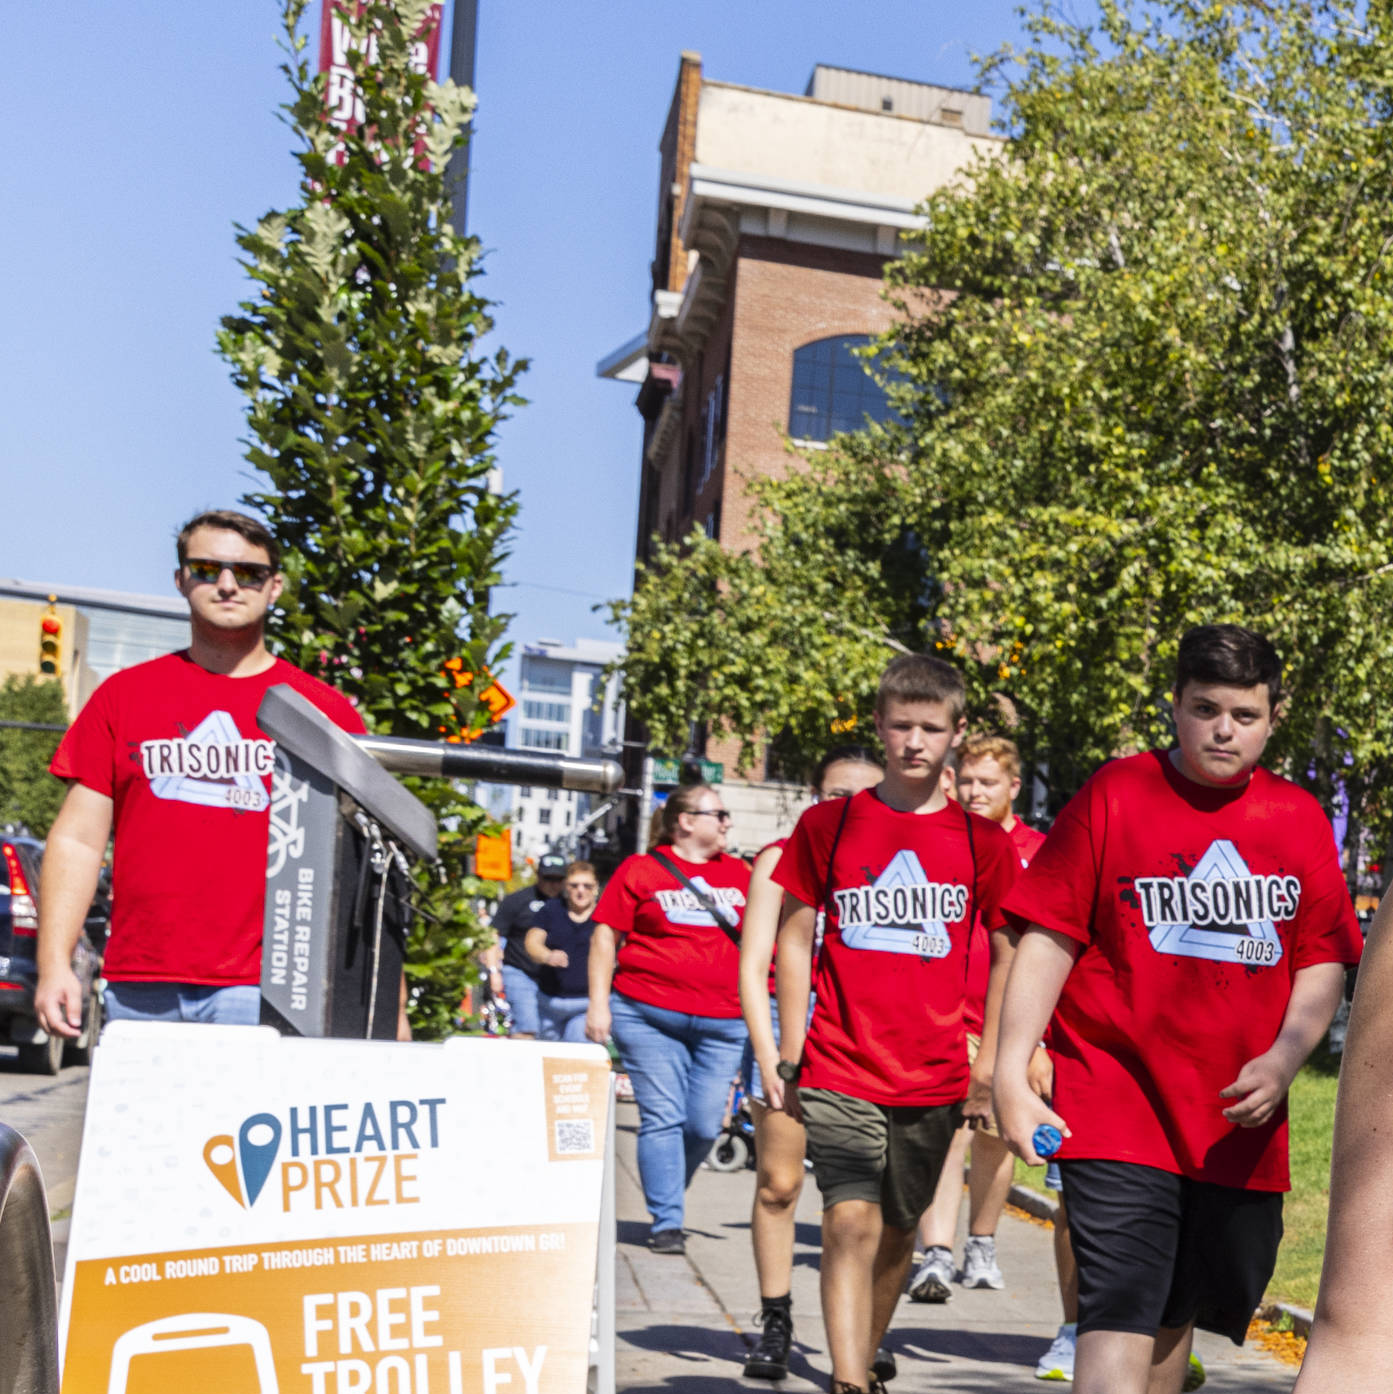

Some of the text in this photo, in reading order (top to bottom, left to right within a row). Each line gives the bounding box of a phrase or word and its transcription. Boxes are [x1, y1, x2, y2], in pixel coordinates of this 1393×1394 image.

[142, 739, 275, 779] TRISONIC
[225, 787, 262, 807] 4003
[835, 883, 968, 927] TRISONICS
[1135, 875, 1301, 925] TRISONICS
[270, 889, 292, 985] STATION
[290, 868, 314, 1011] BIKE REPAIR
[912, 936, 945, 955] 4003
[1236, 939, 1275, 962] 4003
[289, 1098, 446, 1157] HEART
[281, 1154, 421, 1213] PRIZE
[104, 1232, 567, 1286] A COOL ROUND TRIP THROUGH THE HEART OF DOWNTOWN GR!
[303, 1285, 444, 1357] FREE
